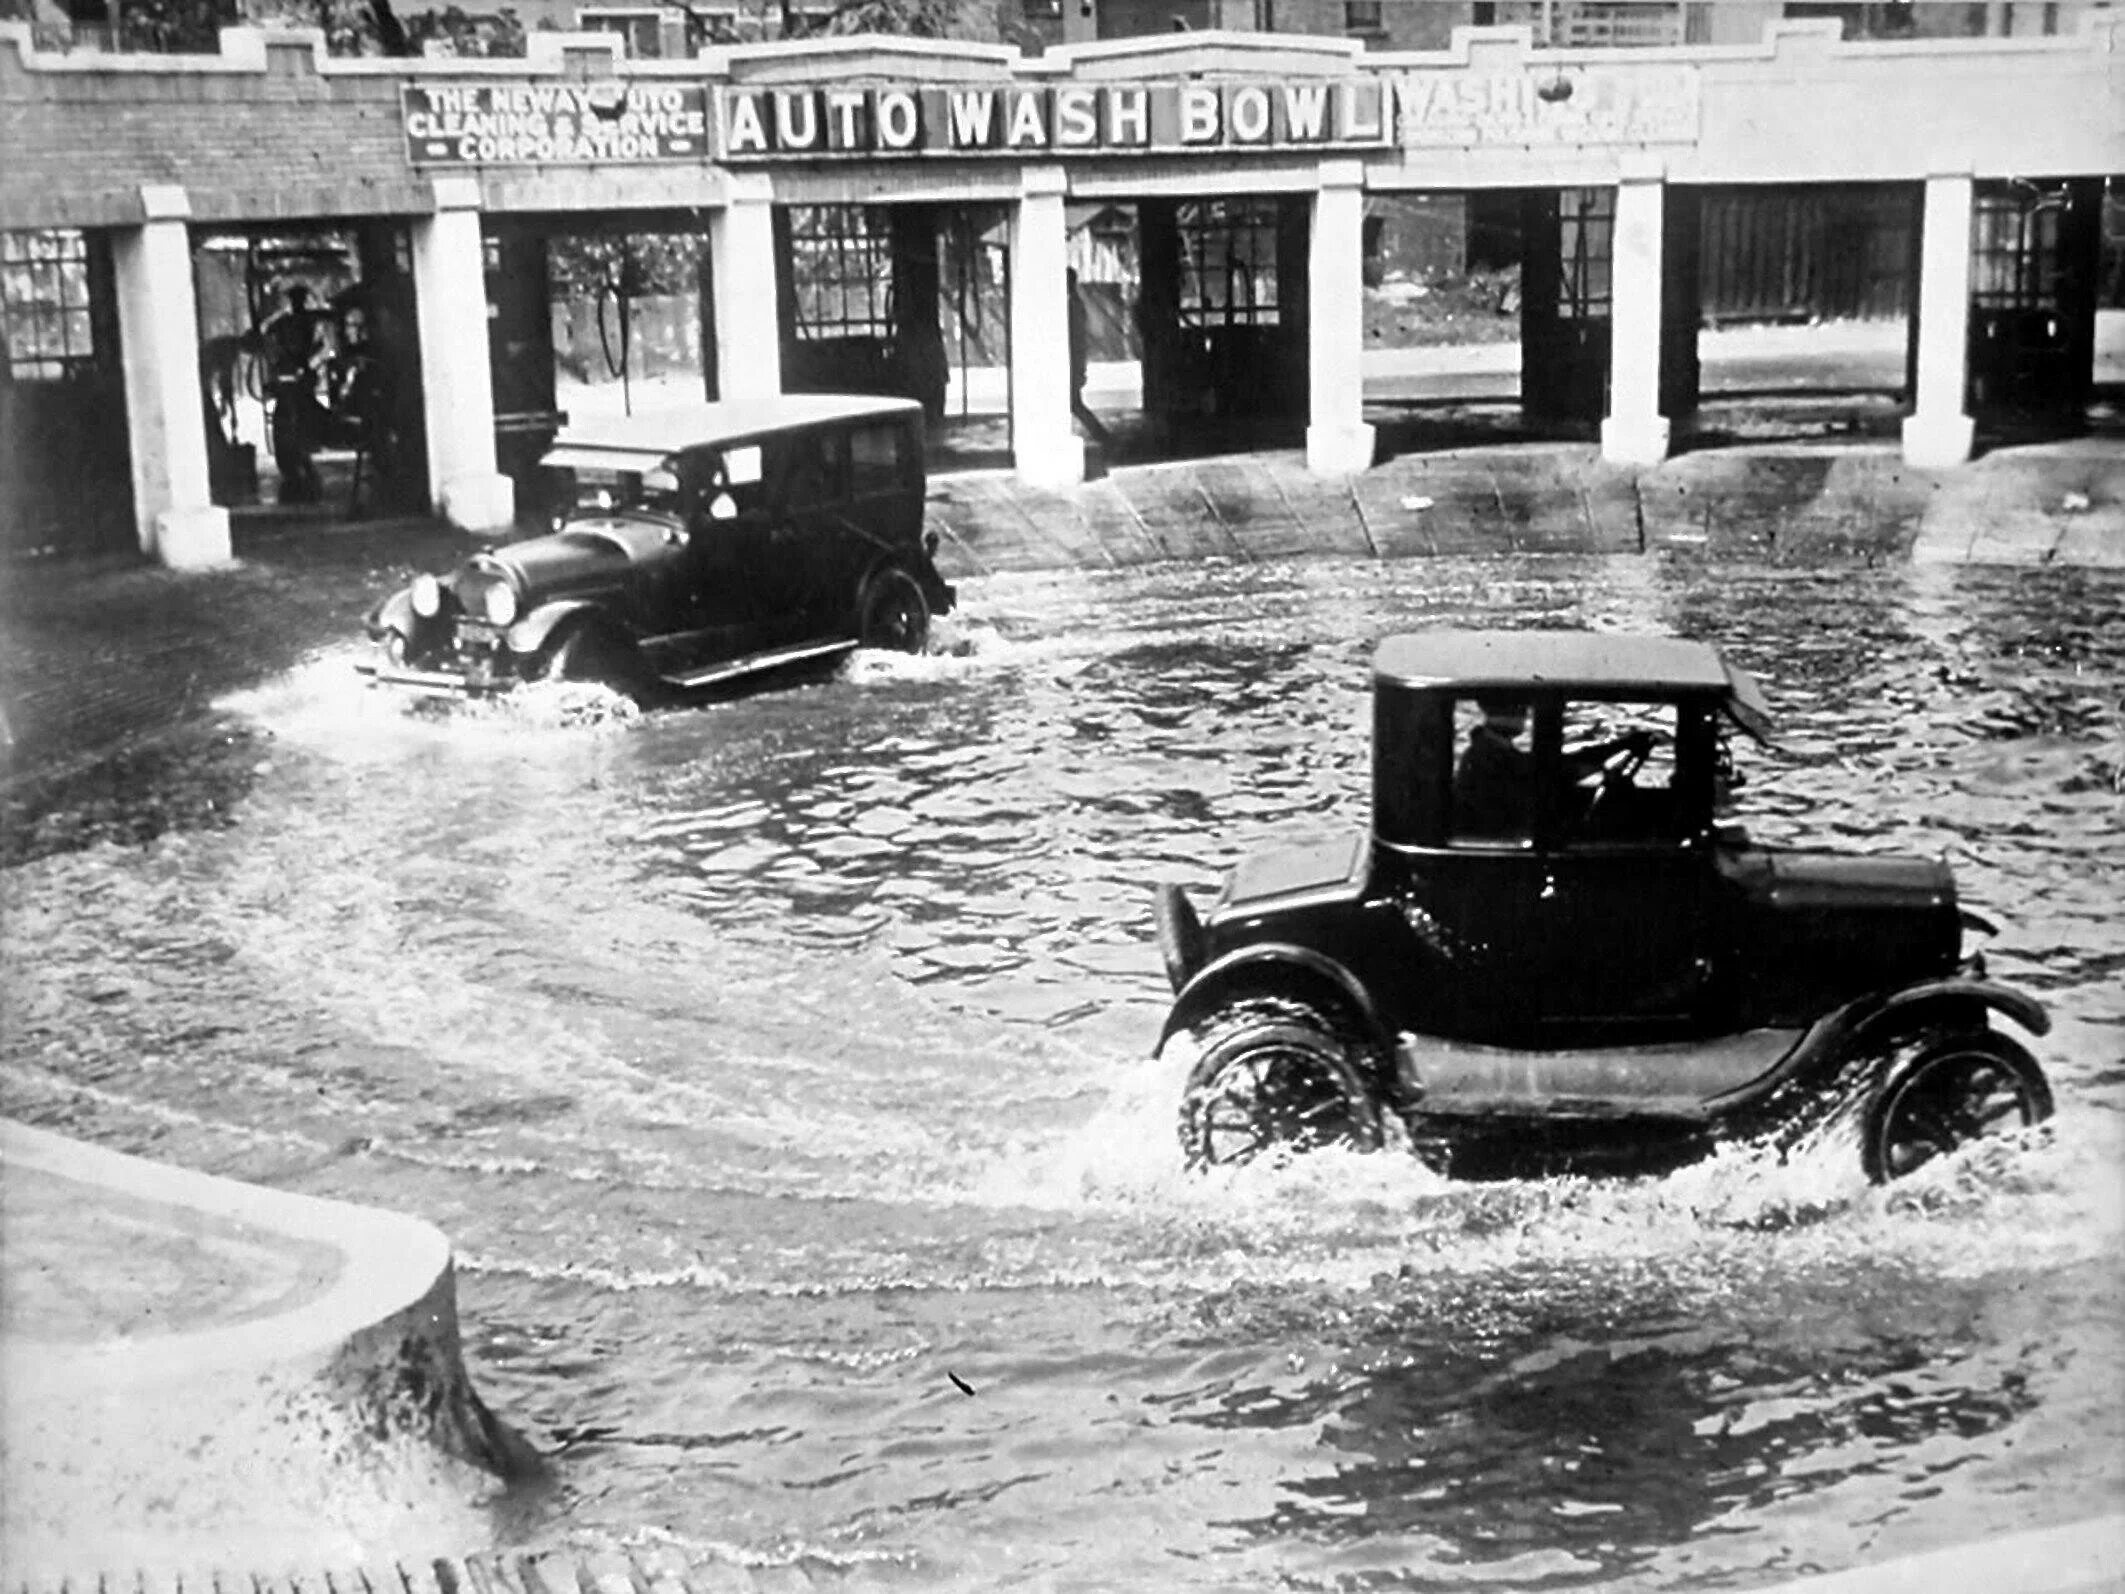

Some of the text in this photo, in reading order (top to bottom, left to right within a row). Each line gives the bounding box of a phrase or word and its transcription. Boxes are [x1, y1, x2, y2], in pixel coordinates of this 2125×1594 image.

[425, 86, 684, 112] THE NEWAY UTO
[407, 112, 550, 137] CLEANING
[553, 117, 575, 136] &
[730, 85, 1381, 151] AUTO WASH BOWL
[458, 134, 660, 160] CORPORATION
